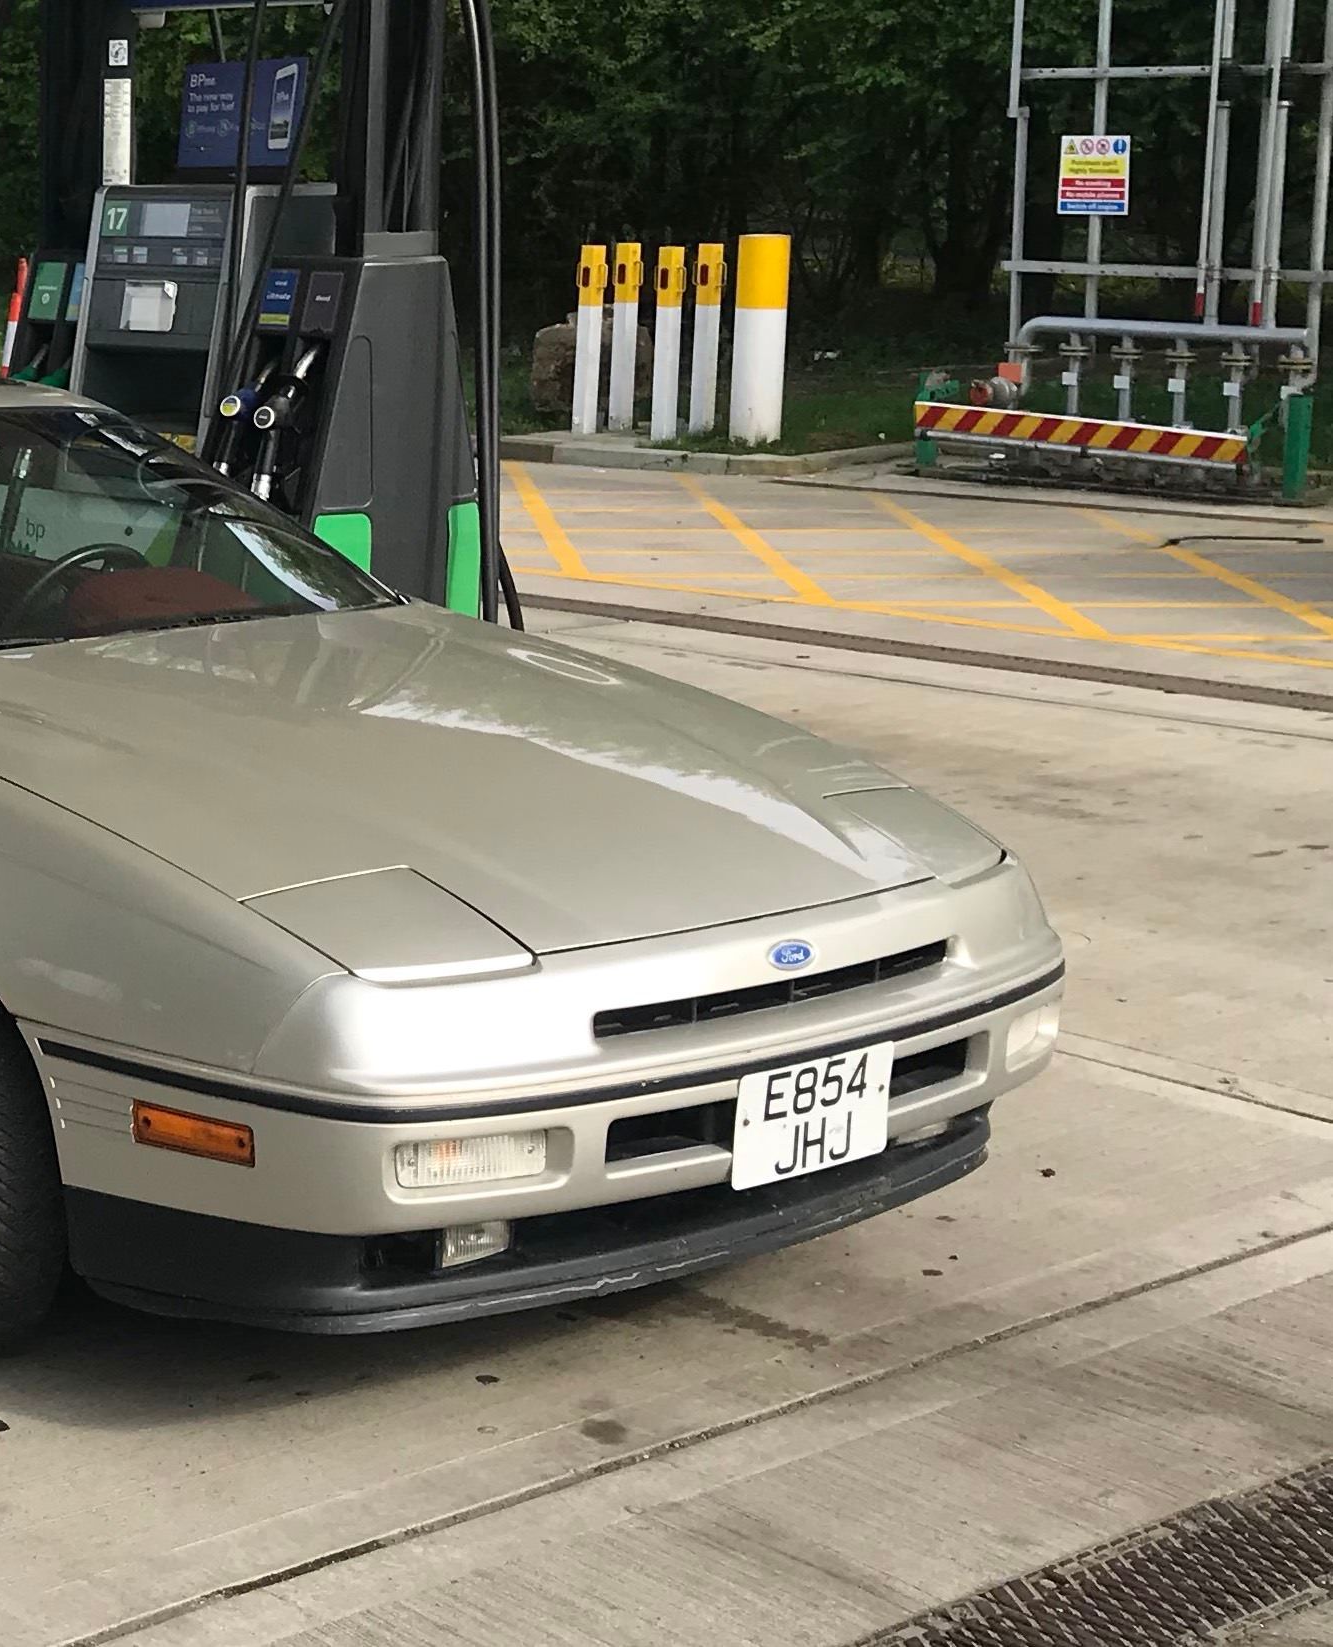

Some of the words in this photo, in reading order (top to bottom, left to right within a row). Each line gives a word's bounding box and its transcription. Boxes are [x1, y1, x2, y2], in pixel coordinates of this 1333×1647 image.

[107, 207, 128, 230] 17
[26, 517, 45, 543] bp
[779, 947, 806, 963] Ford
[763, 1052, 868, 1122] E854
[774, 1110, 852, 1175] JHJ
